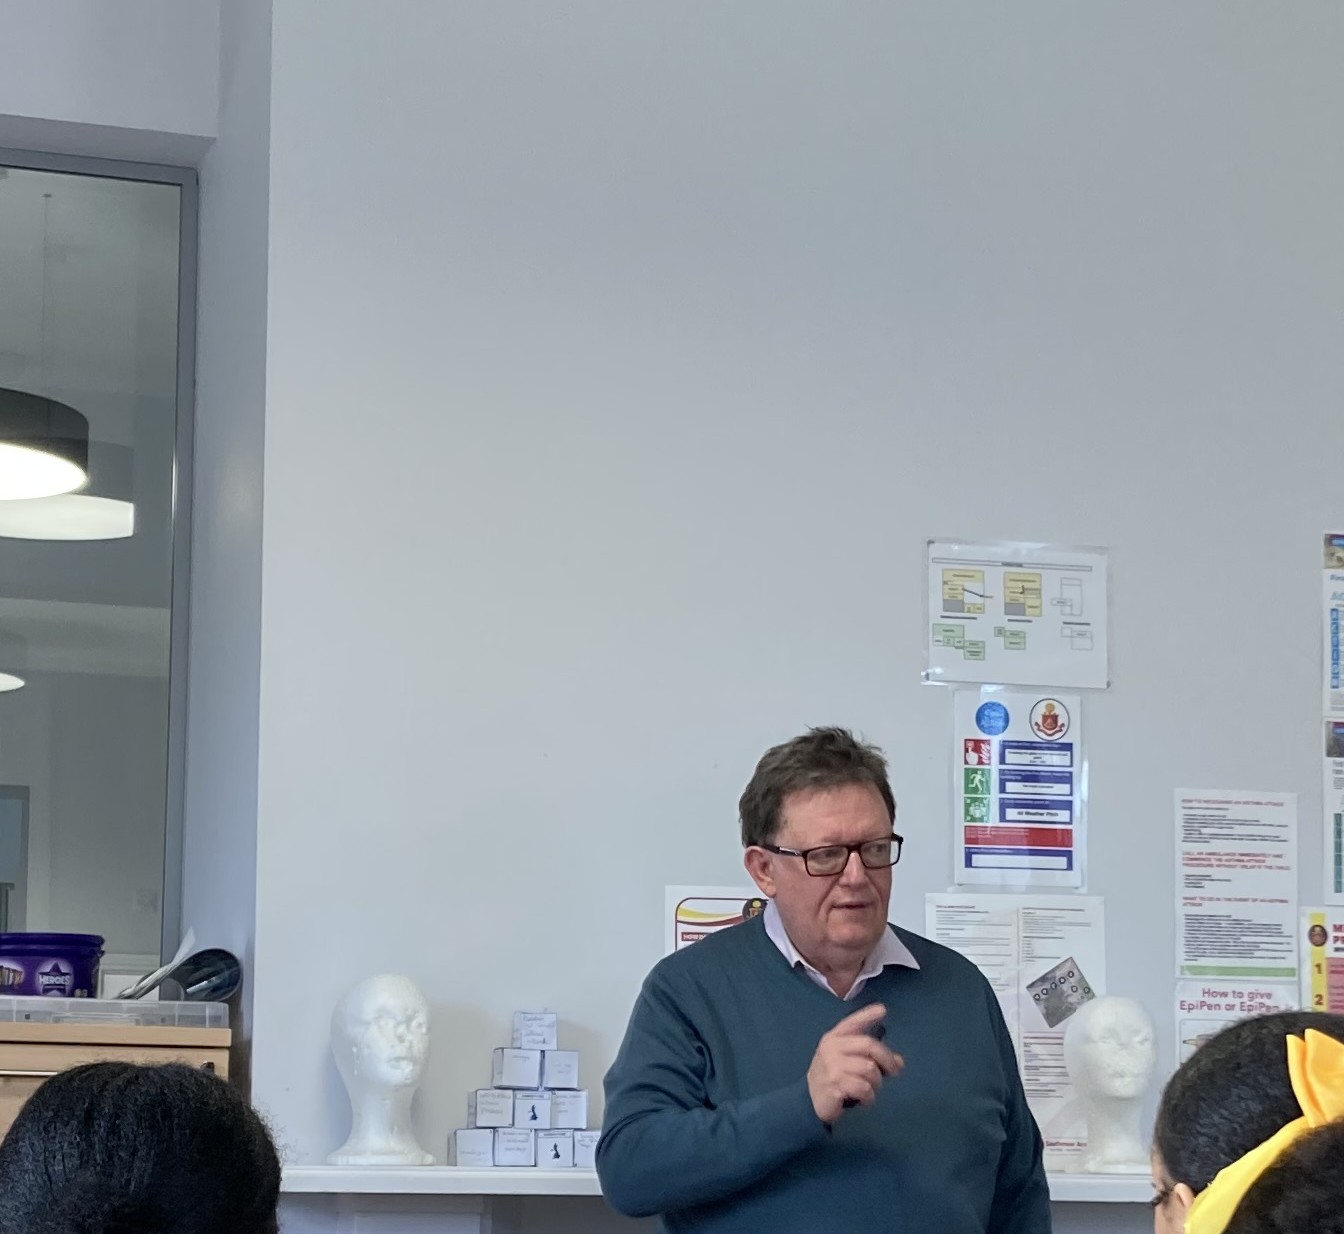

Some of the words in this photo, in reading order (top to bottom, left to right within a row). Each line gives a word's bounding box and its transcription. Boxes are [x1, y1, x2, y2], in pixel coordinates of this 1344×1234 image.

[1314, 963, 1322, 975] 1
[39, 975, 71, 985] HEROES
[1202, 987, 1229, 999] How
[1232, 989, 1245, 999] to
[1247, 988, 1273, 1002] give
[1314, 994, 1324, 1006] 2
[1179, 1000, 1222, 1013] EpiPen
[1224, 1003, 1236, 1011] or
[1239, 1002, 1281, 1013] EpiPen
